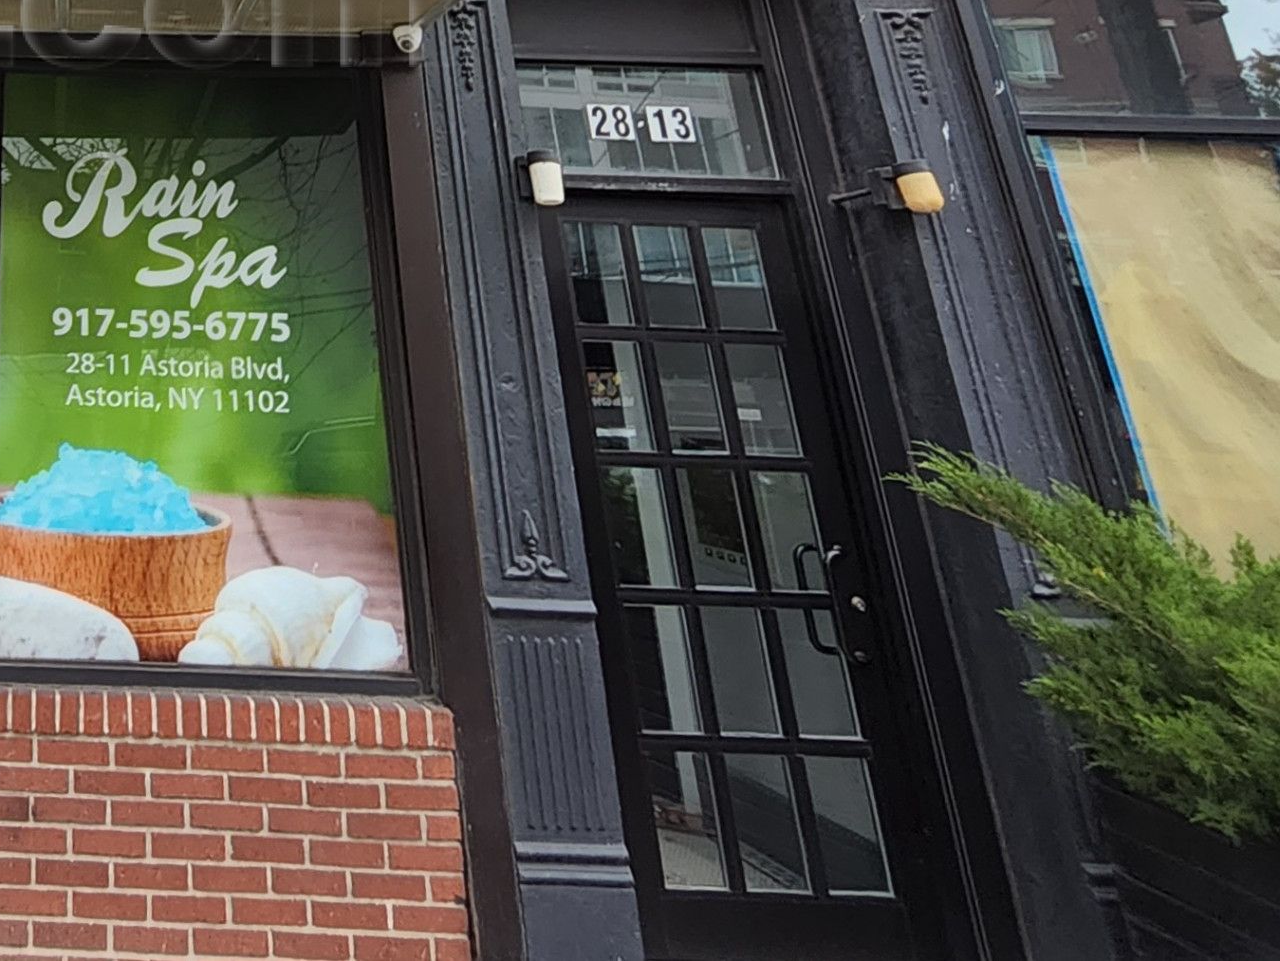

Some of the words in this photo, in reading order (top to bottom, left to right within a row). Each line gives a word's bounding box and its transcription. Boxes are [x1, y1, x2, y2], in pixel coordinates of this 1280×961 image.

[42, 148, 239, 239] Rain
[135, 217, 287, 309] Spa
[51, 306, 291, 342] 917-595-6775
[65, 352, 130, 375] 28-11
[139, 354, 224, 379] Astoria
[230, 356, 290, 383] Blvd,
[65, 384, 162, 412] Astoria,
[168, 387, 205, 410] NY
[213, 390, 290, 413] 11102
